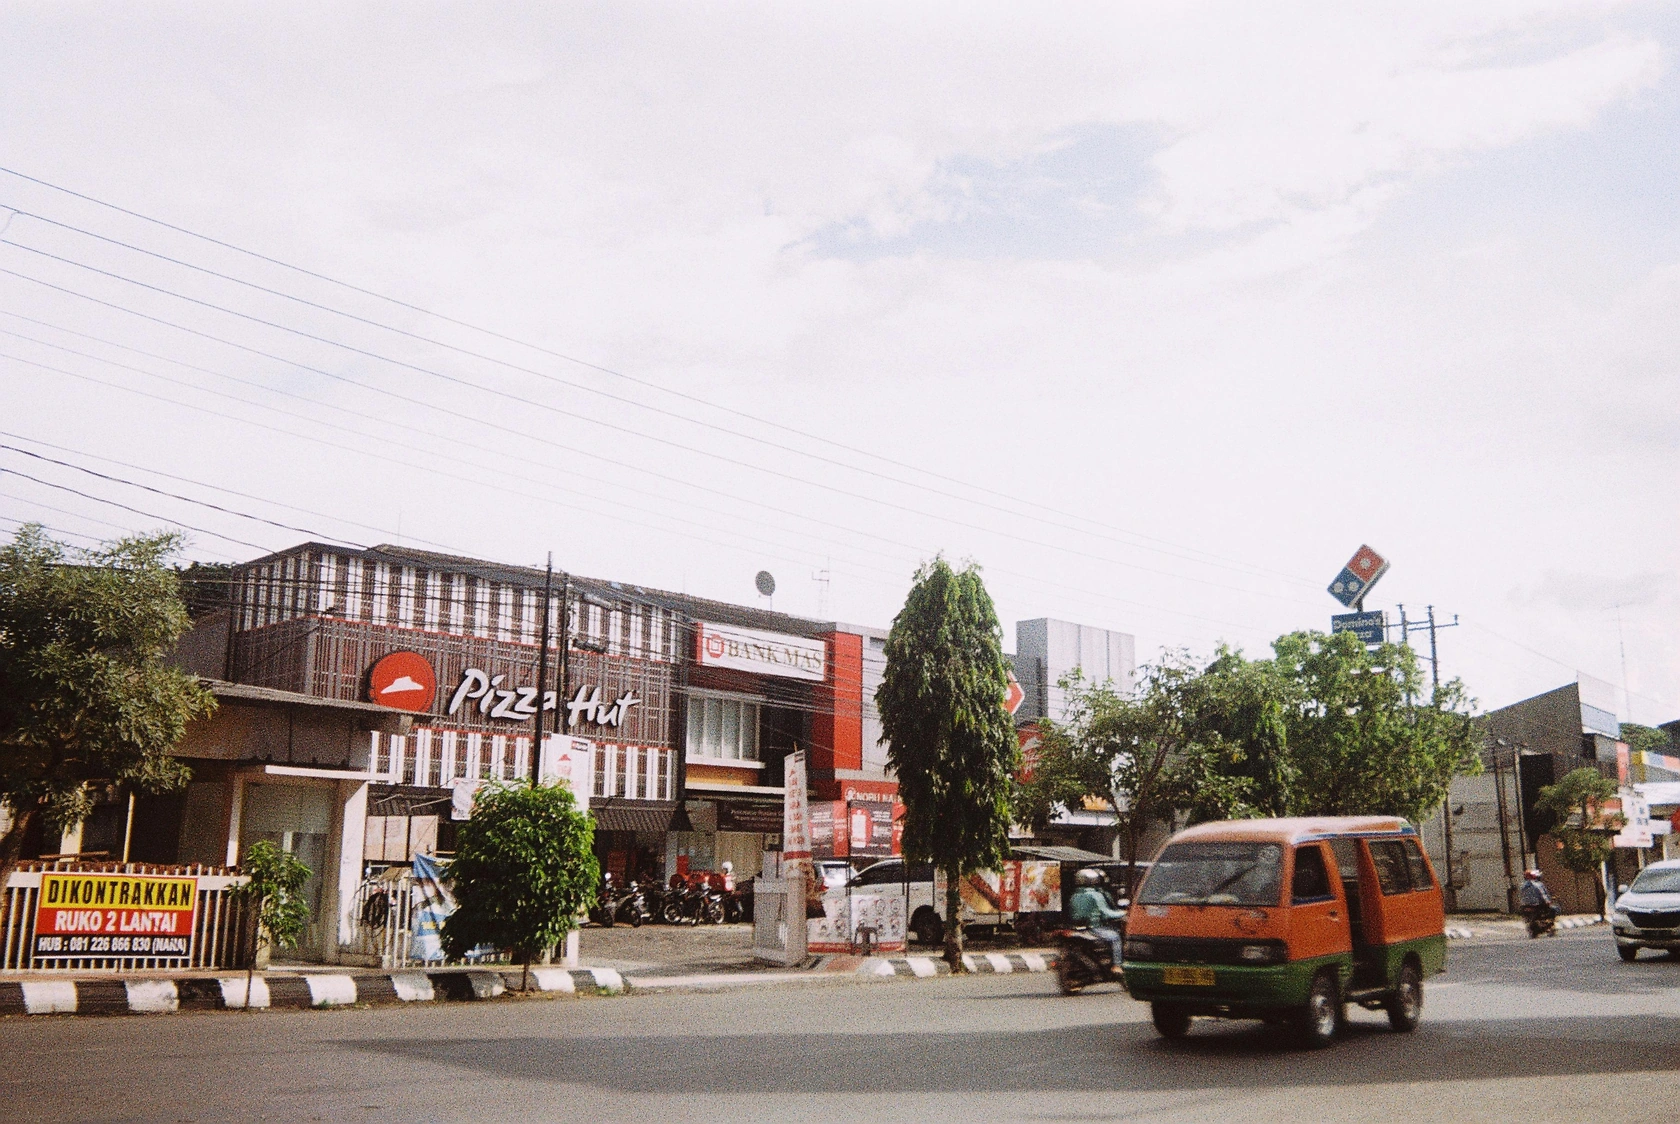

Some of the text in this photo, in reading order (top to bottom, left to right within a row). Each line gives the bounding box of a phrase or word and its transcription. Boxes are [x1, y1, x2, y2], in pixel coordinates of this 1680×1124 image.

[727, 640, 822, 669] BANK MAS
[566, 685, 641, 727] Hut
[47, 880, 192, 907] DIKONTRAKKAN
[54, 910, 178, 933] RUKO 2 LANTAI
[38, 937, 62, 951] HUB
[69, 937, 90, 951] 081
[90, 937, 111, 951] 226
[132, 938, 151, 952] 830
